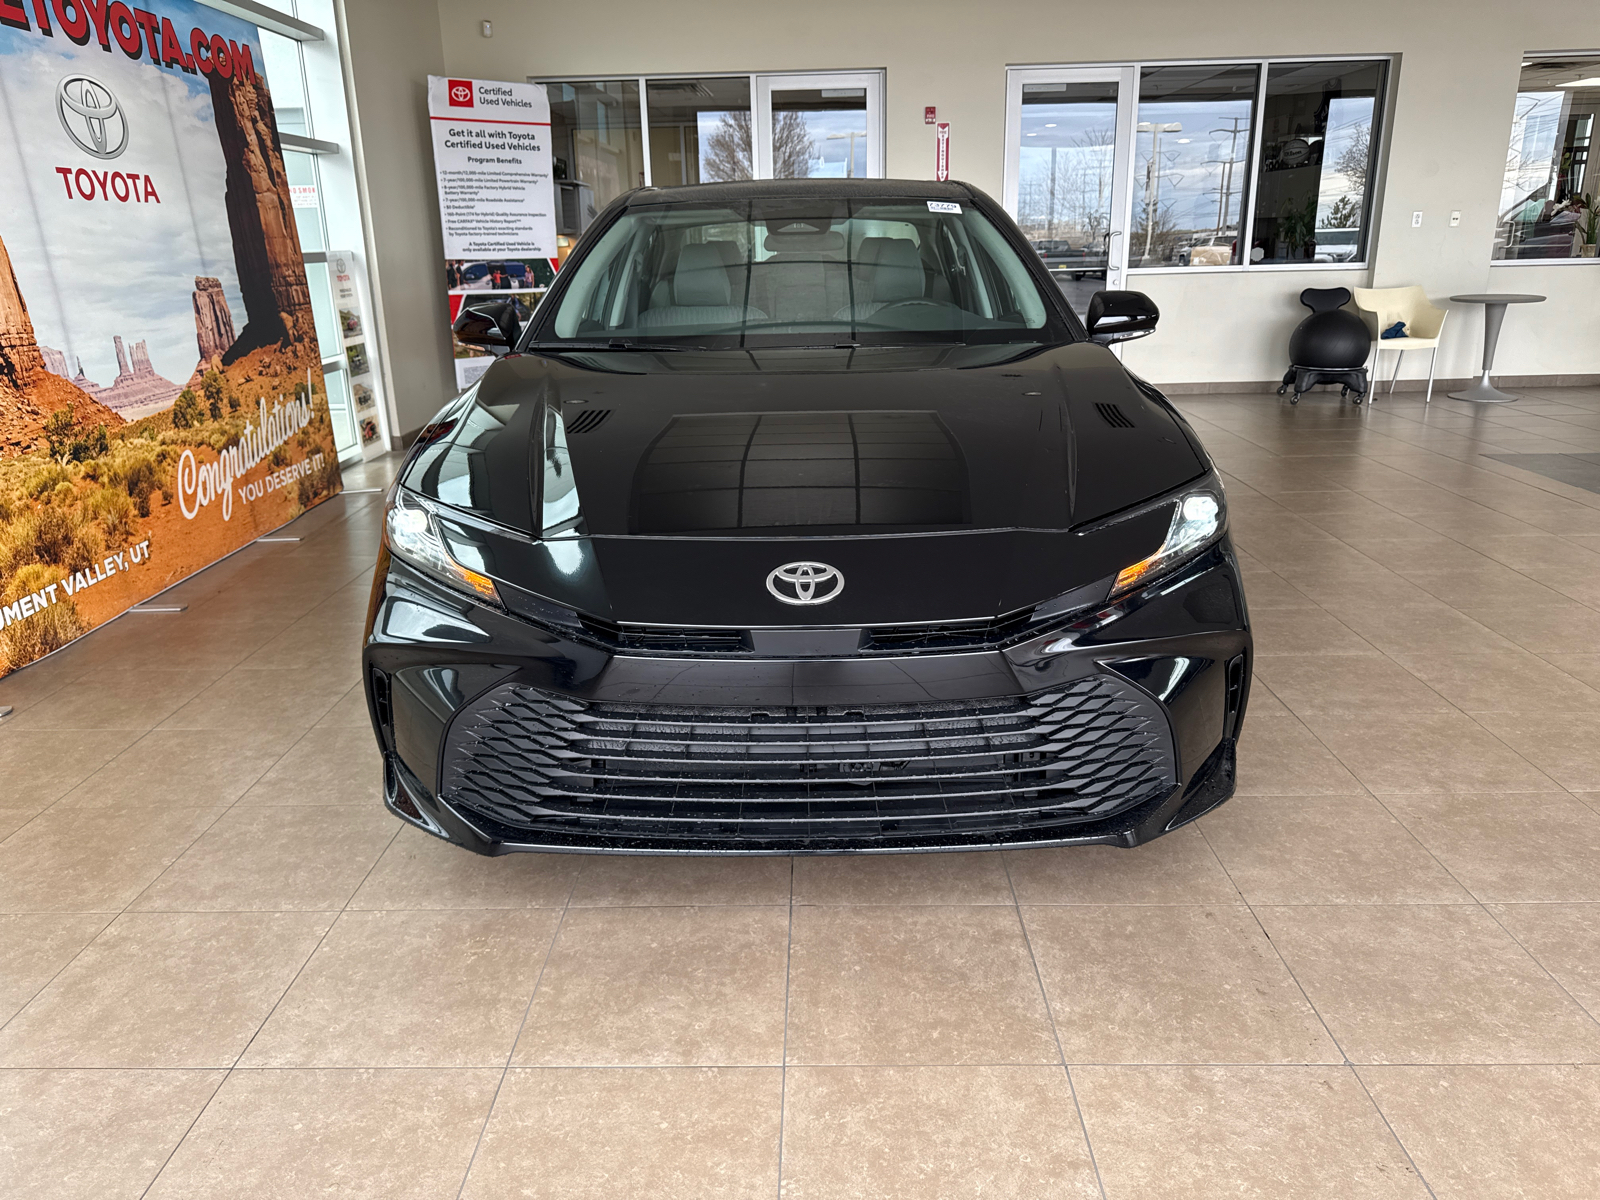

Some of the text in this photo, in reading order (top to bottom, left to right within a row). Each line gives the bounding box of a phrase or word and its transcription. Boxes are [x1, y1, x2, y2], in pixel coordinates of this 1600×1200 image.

[0, 0, 257, 85] TOYOTA.COM
[478, 86, 513, 97] Certified
[479, 97, 532, 108] Used Vehicles
[444, 140, 541, 152] Certified Used Vehicles
[448, 128, 536, 141] Get it all with Toyota
[467, 156, 523, 165] Program Benefits
[55, 166, 161, 204] TOYOTA
[178, 368, 314, 521] Congratulations!
[238, 452, 325, 505] YOU DESERVE IT!
[60, 551, 129, 597] VALLEY,
[129, 540, 149, 564] UT
